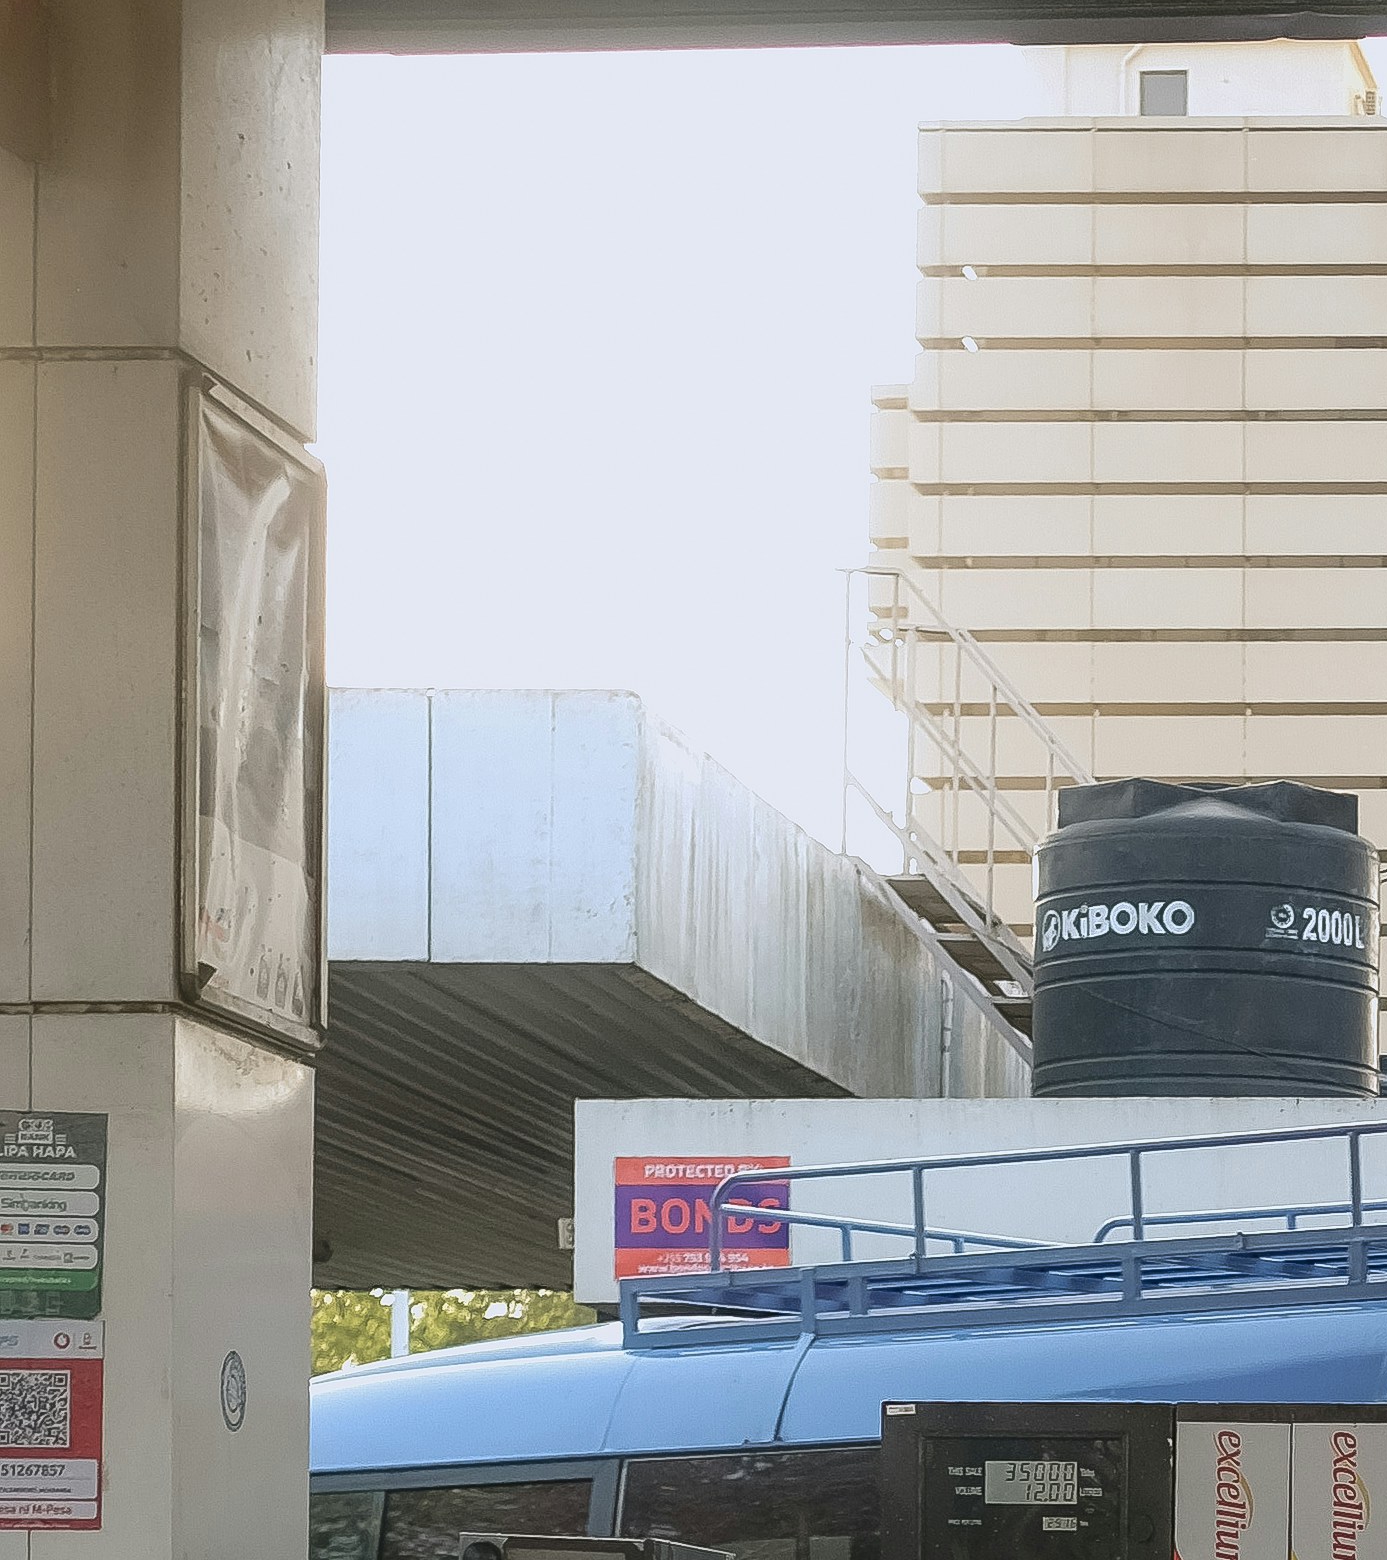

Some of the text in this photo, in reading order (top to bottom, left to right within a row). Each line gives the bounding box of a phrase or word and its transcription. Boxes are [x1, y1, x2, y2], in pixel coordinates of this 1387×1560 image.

[0, 1144, 78, 1158] IPA HAPA
[644, 1163, 735, 1178] PROTECTED
[631, 1197, 783, 1235] BONDS
[1026, 1483, 1075, 1502] 12.00
